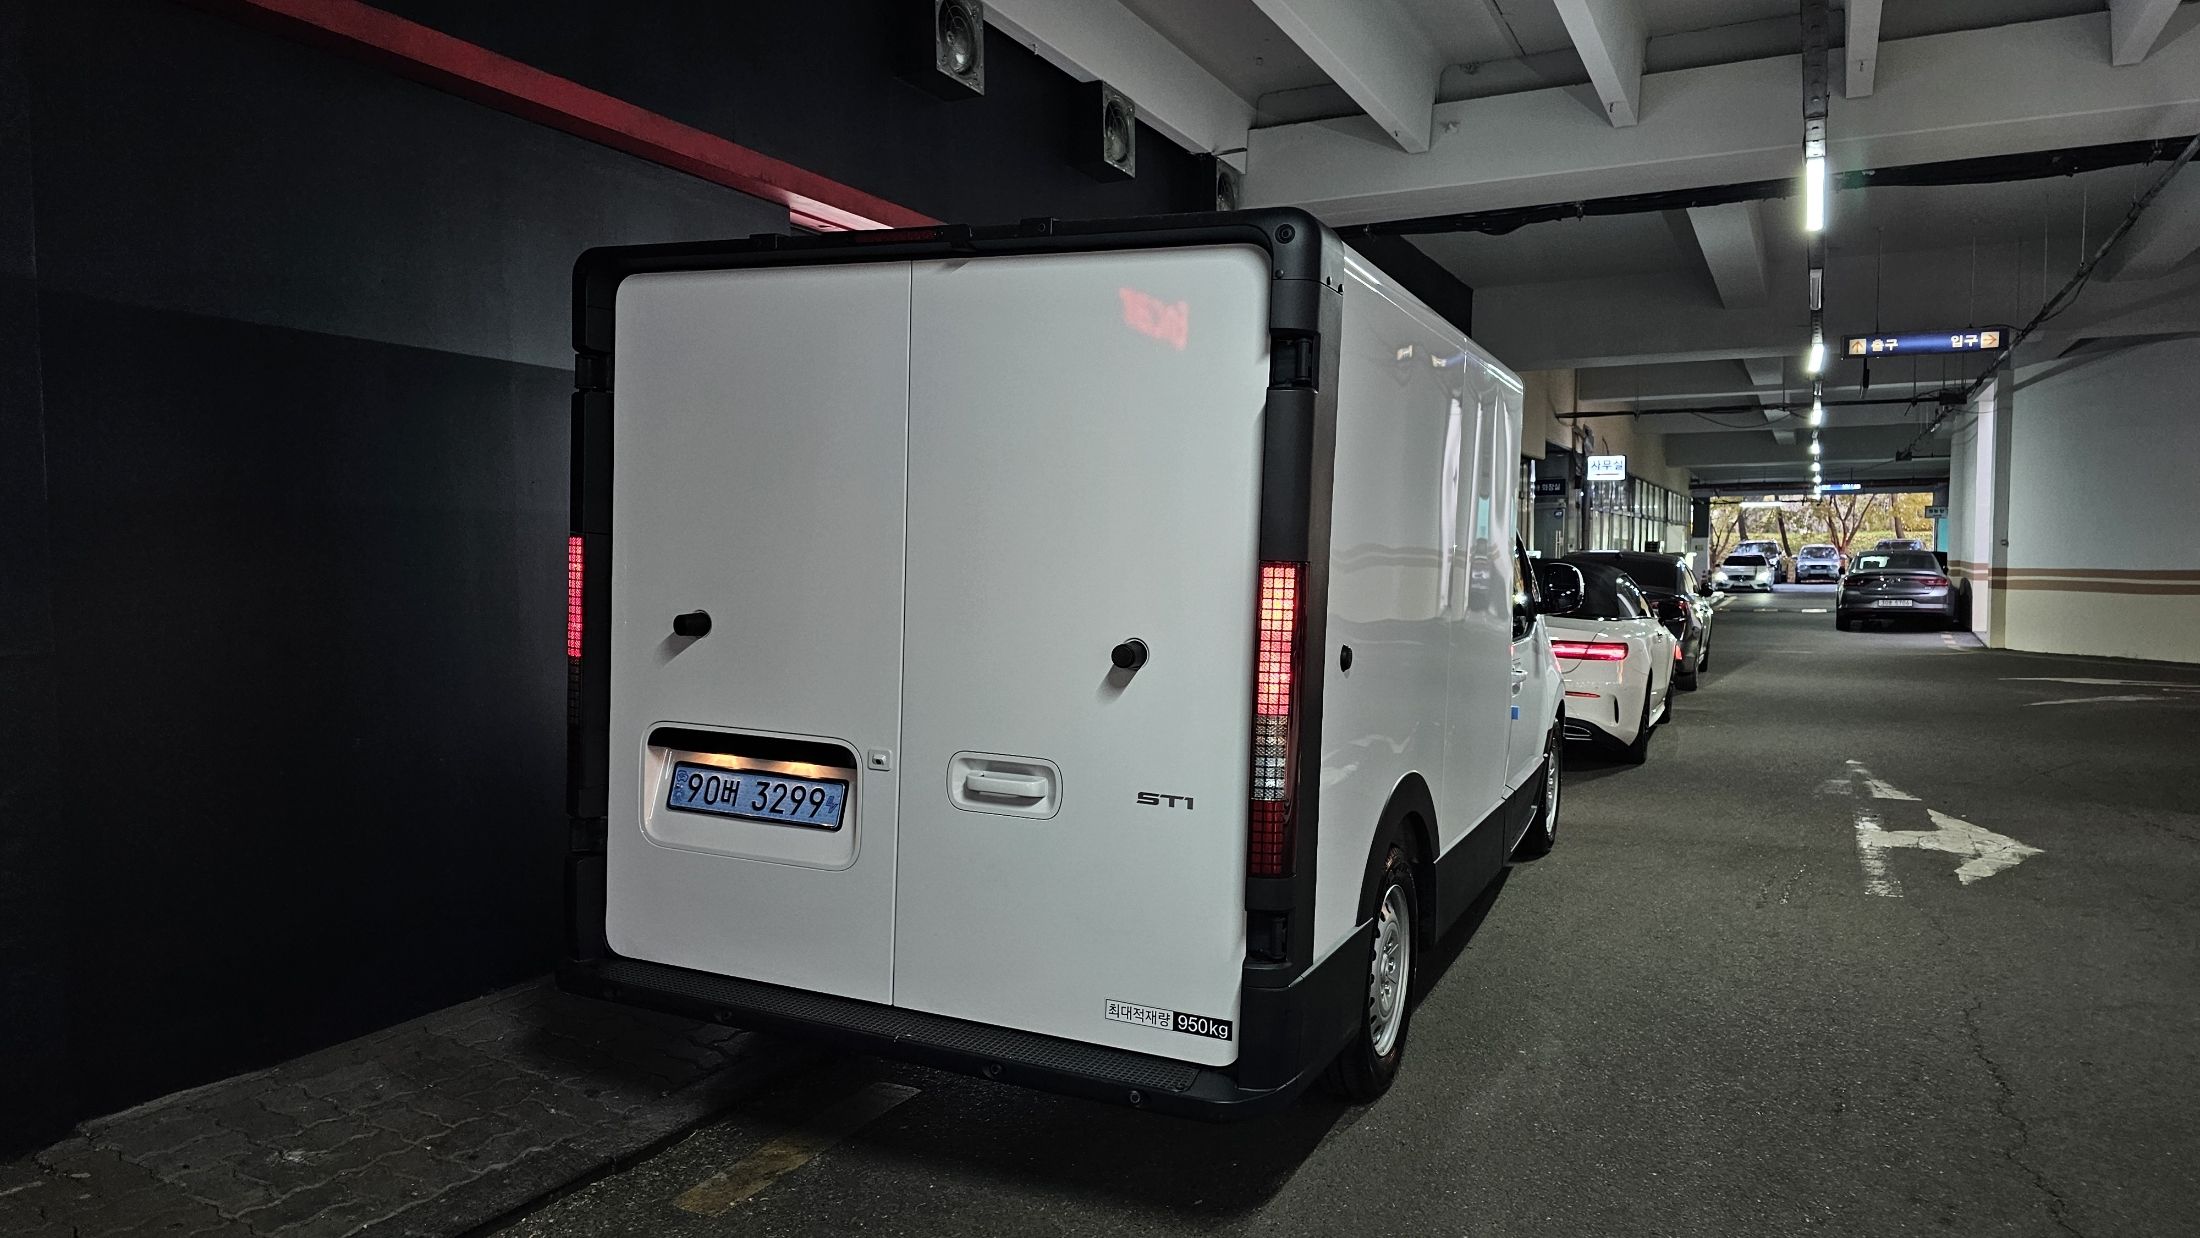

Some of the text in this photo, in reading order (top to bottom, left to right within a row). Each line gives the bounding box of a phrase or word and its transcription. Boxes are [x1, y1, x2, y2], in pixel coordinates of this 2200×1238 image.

[1950, 334, 1979, 348] 입구
[1592, 460, 1623, 471] 사무실
[687, 773, 826, 818] 90버 3299
[1136, 791, 1194, 810] ST1
[1108, 1003, 1229, 1039] 최대적재량 950kg
